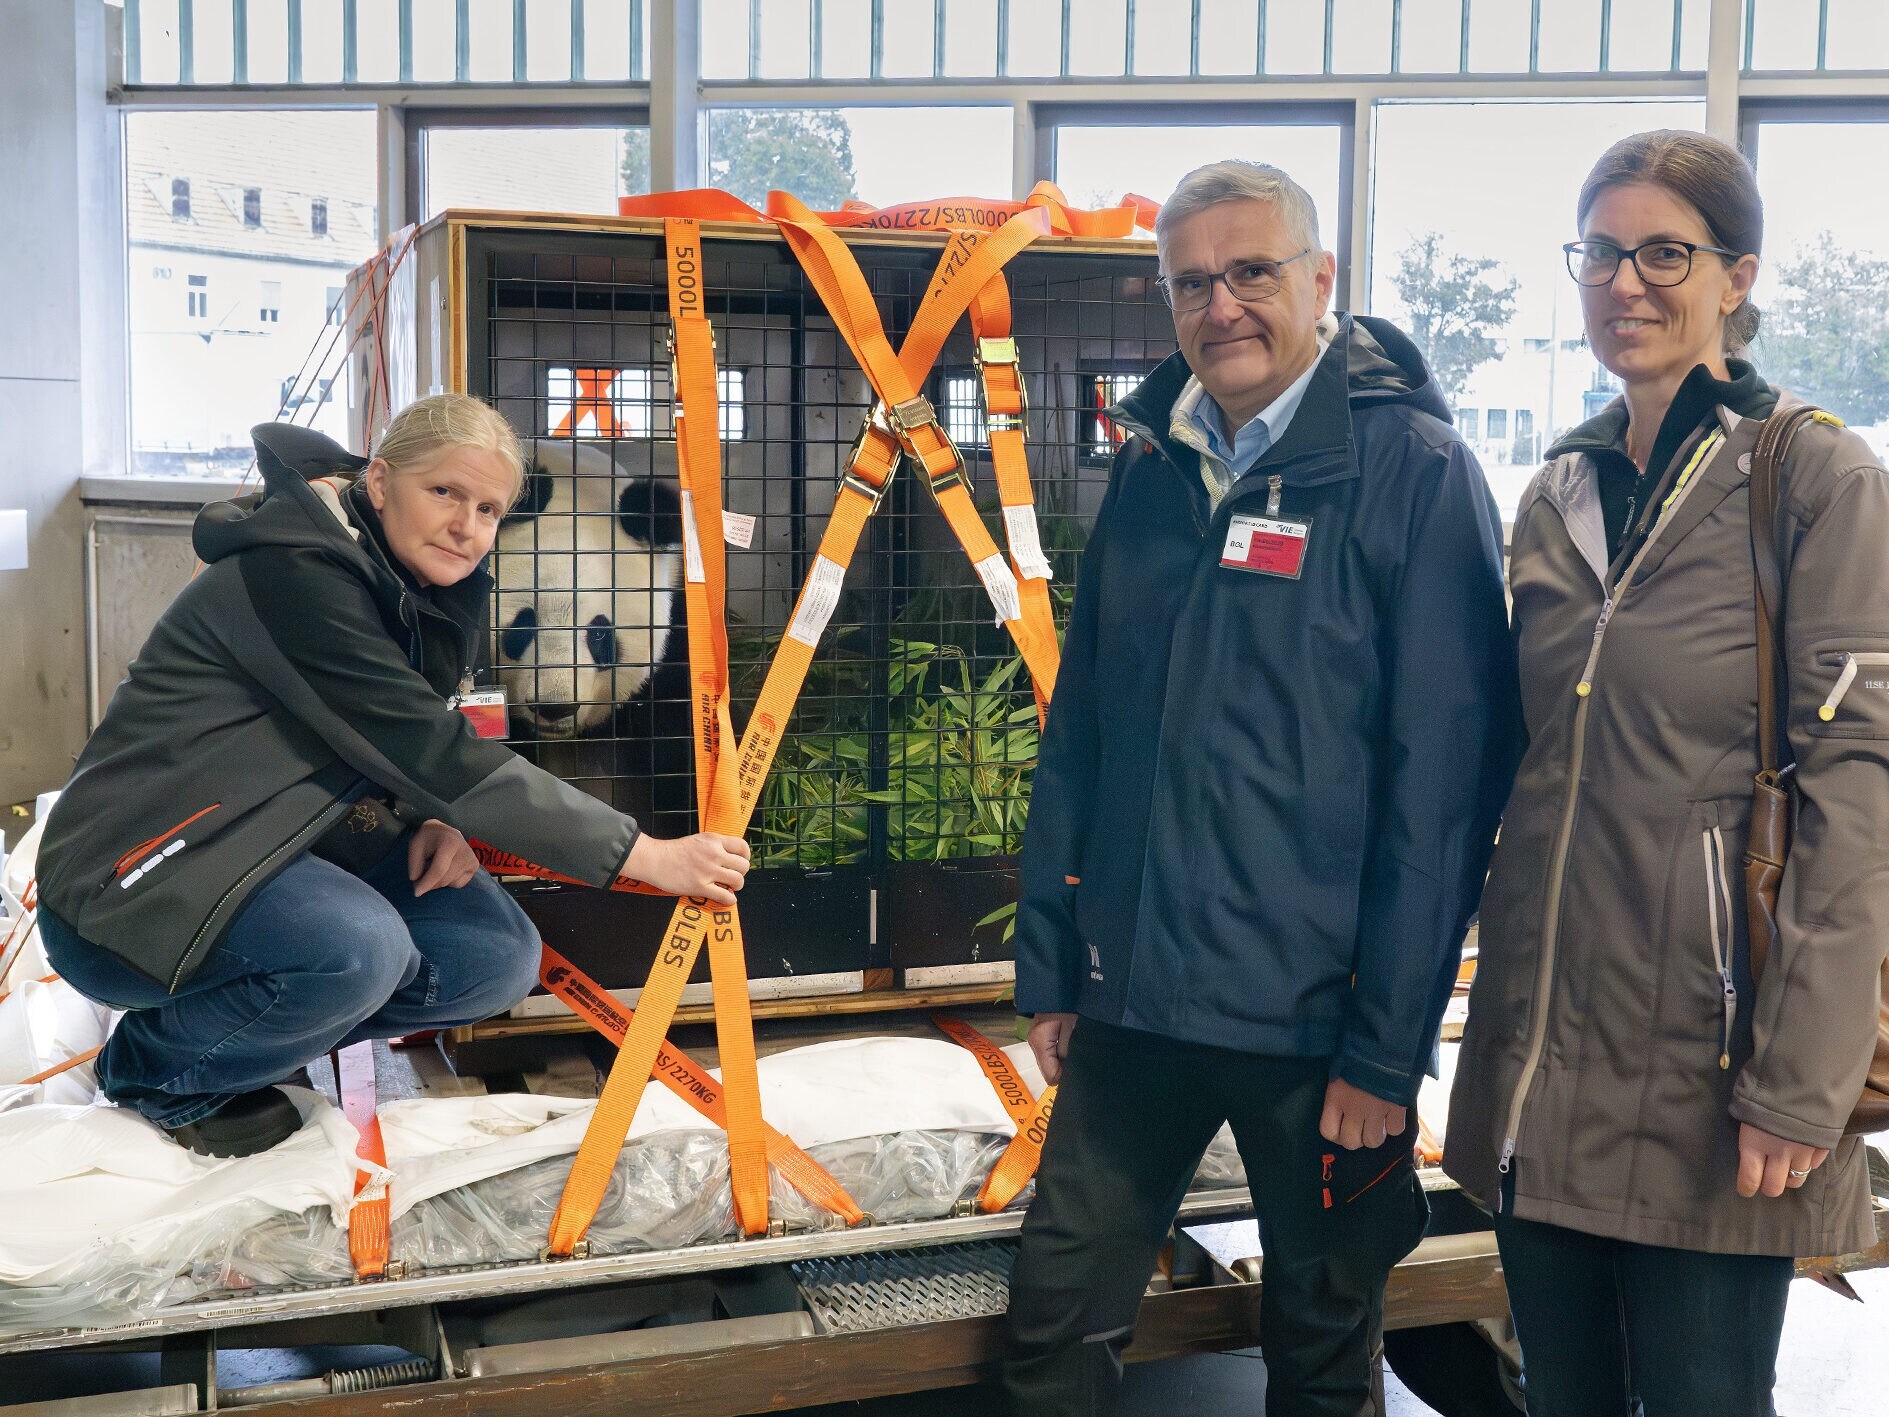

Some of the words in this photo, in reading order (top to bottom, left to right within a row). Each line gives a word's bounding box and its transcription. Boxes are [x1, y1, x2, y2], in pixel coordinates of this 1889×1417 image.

[675, 246, 698, 317] 5000L
[1279, 525, 1294, 534] VIE
[701, 693, 710, 713] AIR
[702, 717, 712, 753] CHINA
[748, 731, 760, 751] AIR
[713, 911, 733, 942] BS
